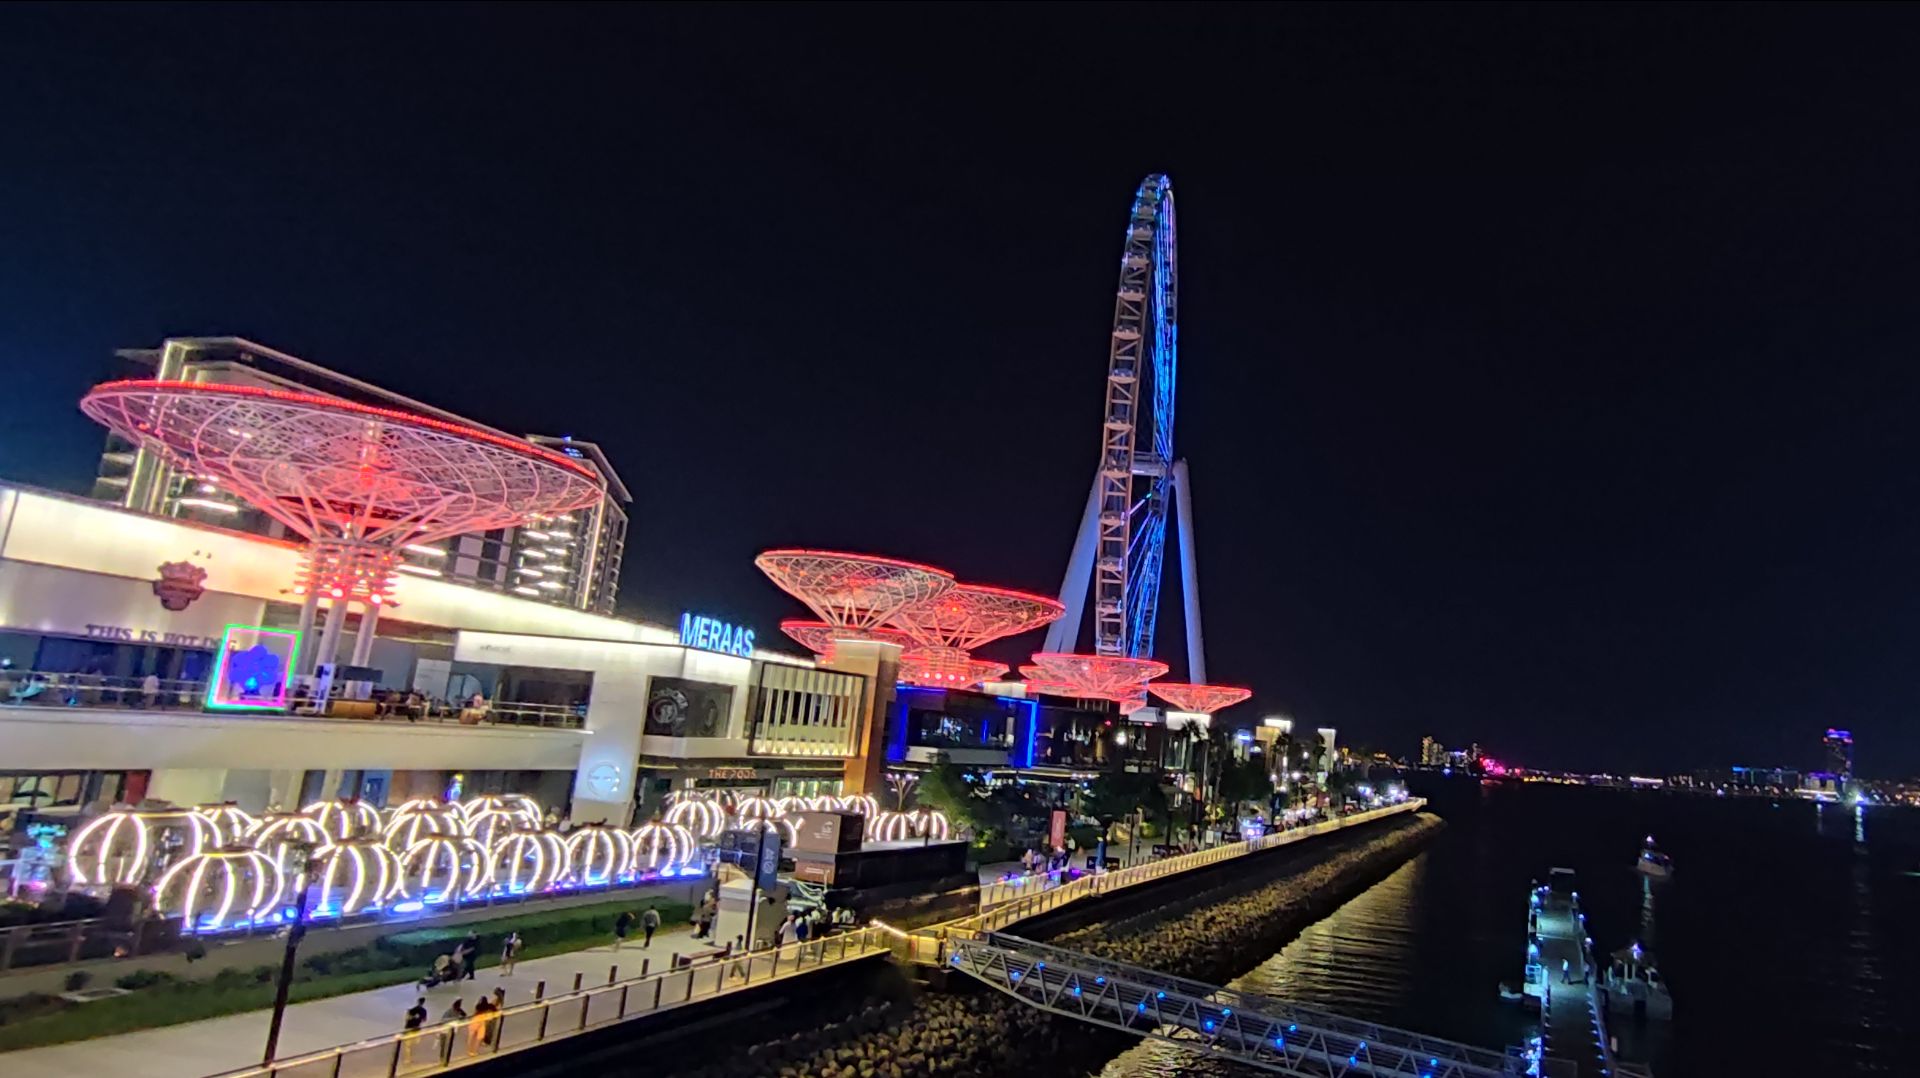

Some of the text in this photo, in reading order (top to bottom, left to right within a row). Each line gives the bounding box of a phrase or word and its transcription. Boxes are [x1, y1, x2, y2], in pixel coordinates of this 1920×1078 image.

[86, 623, 133, 641] THIS
[140, 630, 158, 643] IS
[163, 633, 199, 647] HOT
[680, 612, 755, 657] MERAAS
[708, 768, 727, 779] THE
